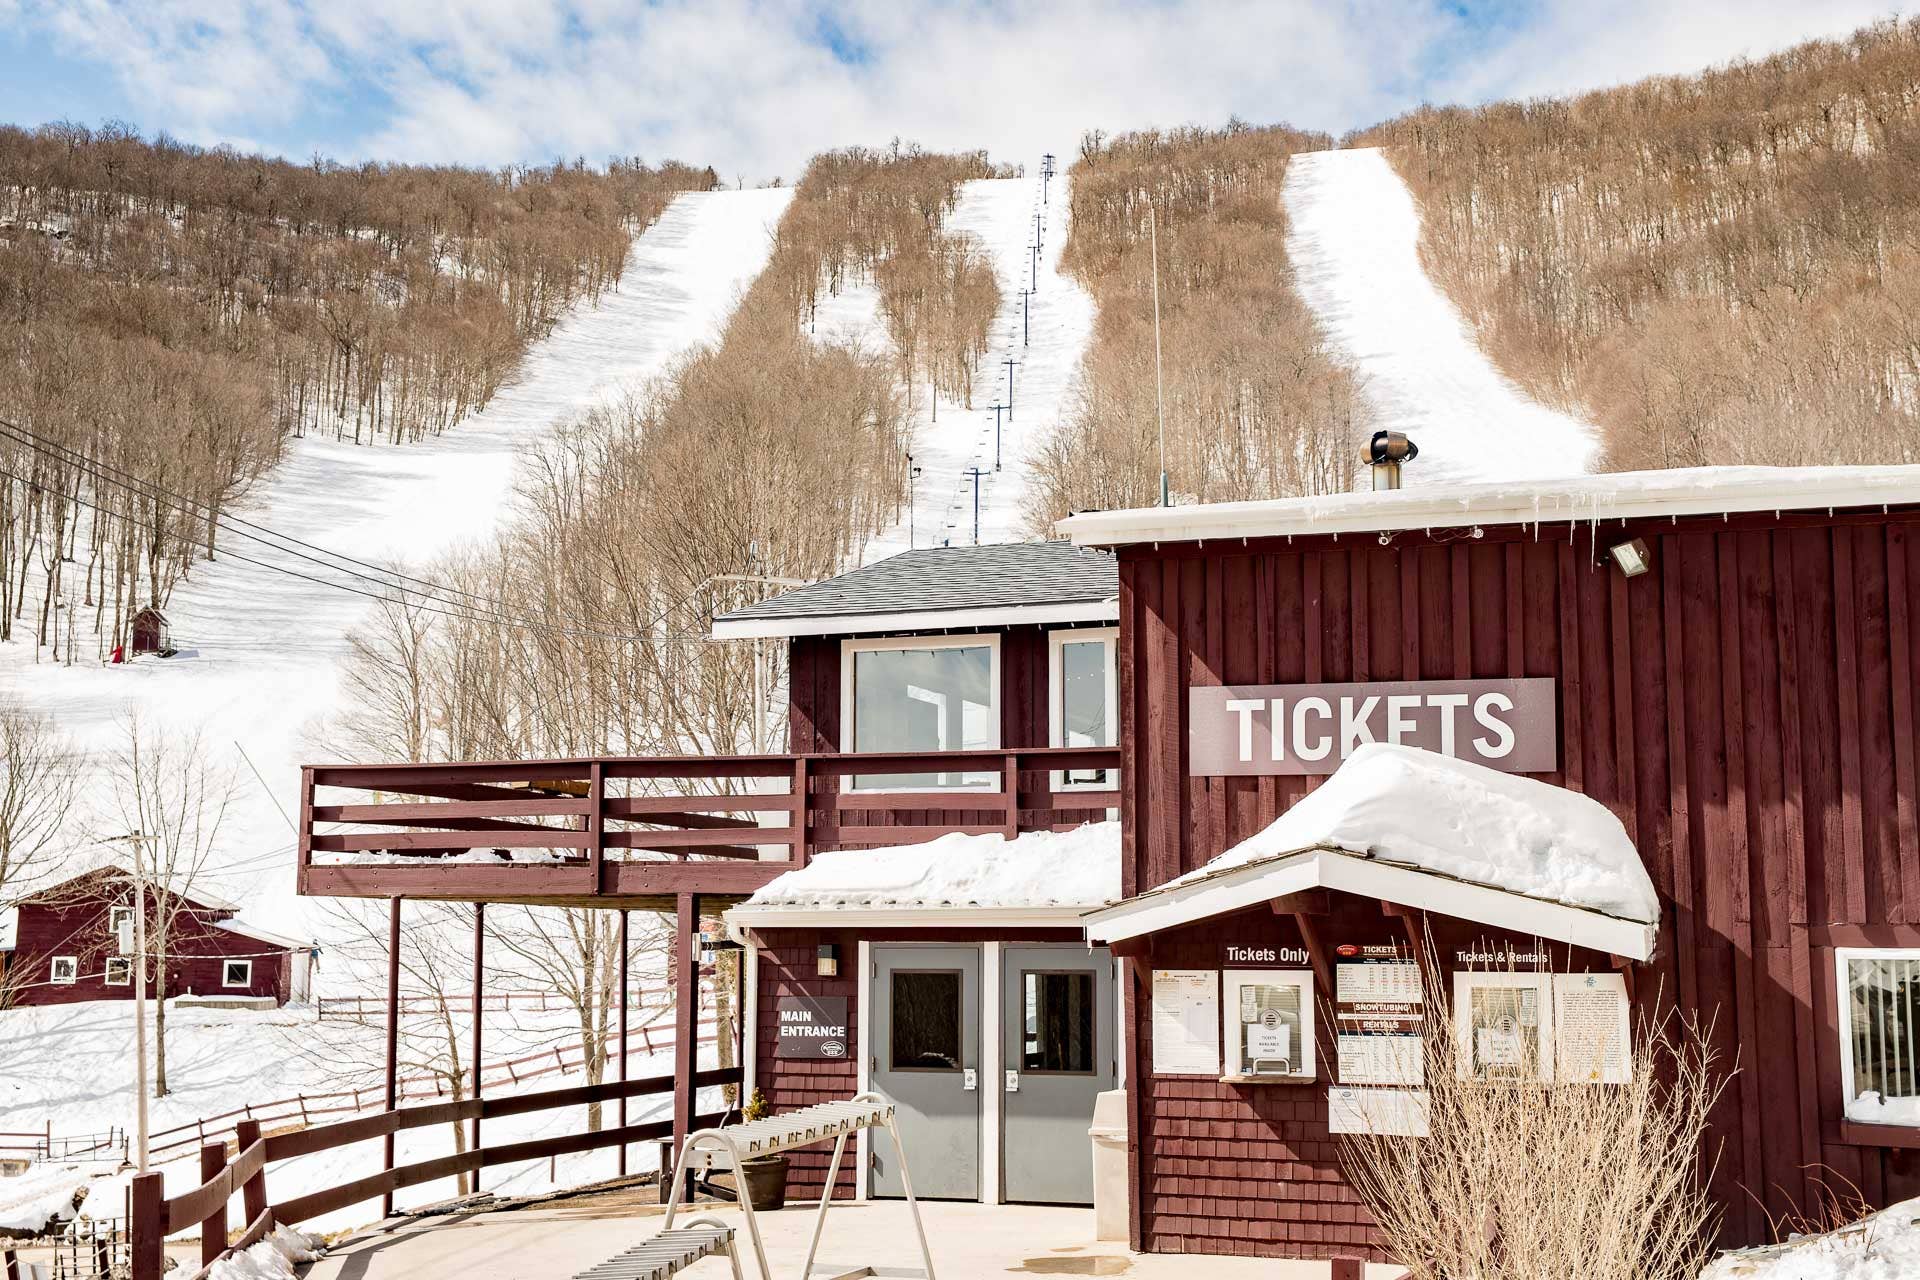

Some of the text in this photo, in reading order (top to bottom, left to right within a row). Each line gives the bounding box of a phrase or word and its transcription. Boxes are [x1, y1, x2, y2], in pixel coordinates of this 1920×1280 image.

[1225, 692, 1516, 762] TICKETS
[1363, 945, 1397, 953] TICKETS
[1226, 946, 1310, 965] Tickets Only
[1456, 951, 1548, 963] Tickets & Rentals
[1355, 1003, 1409, 1011] SNOWTUBING
[781, 1010, 812, 1022] MAIN
[1363, 1020, 1399, 1028] RENTALS
[781, 1025, 845, 1037] ENTRANCE
